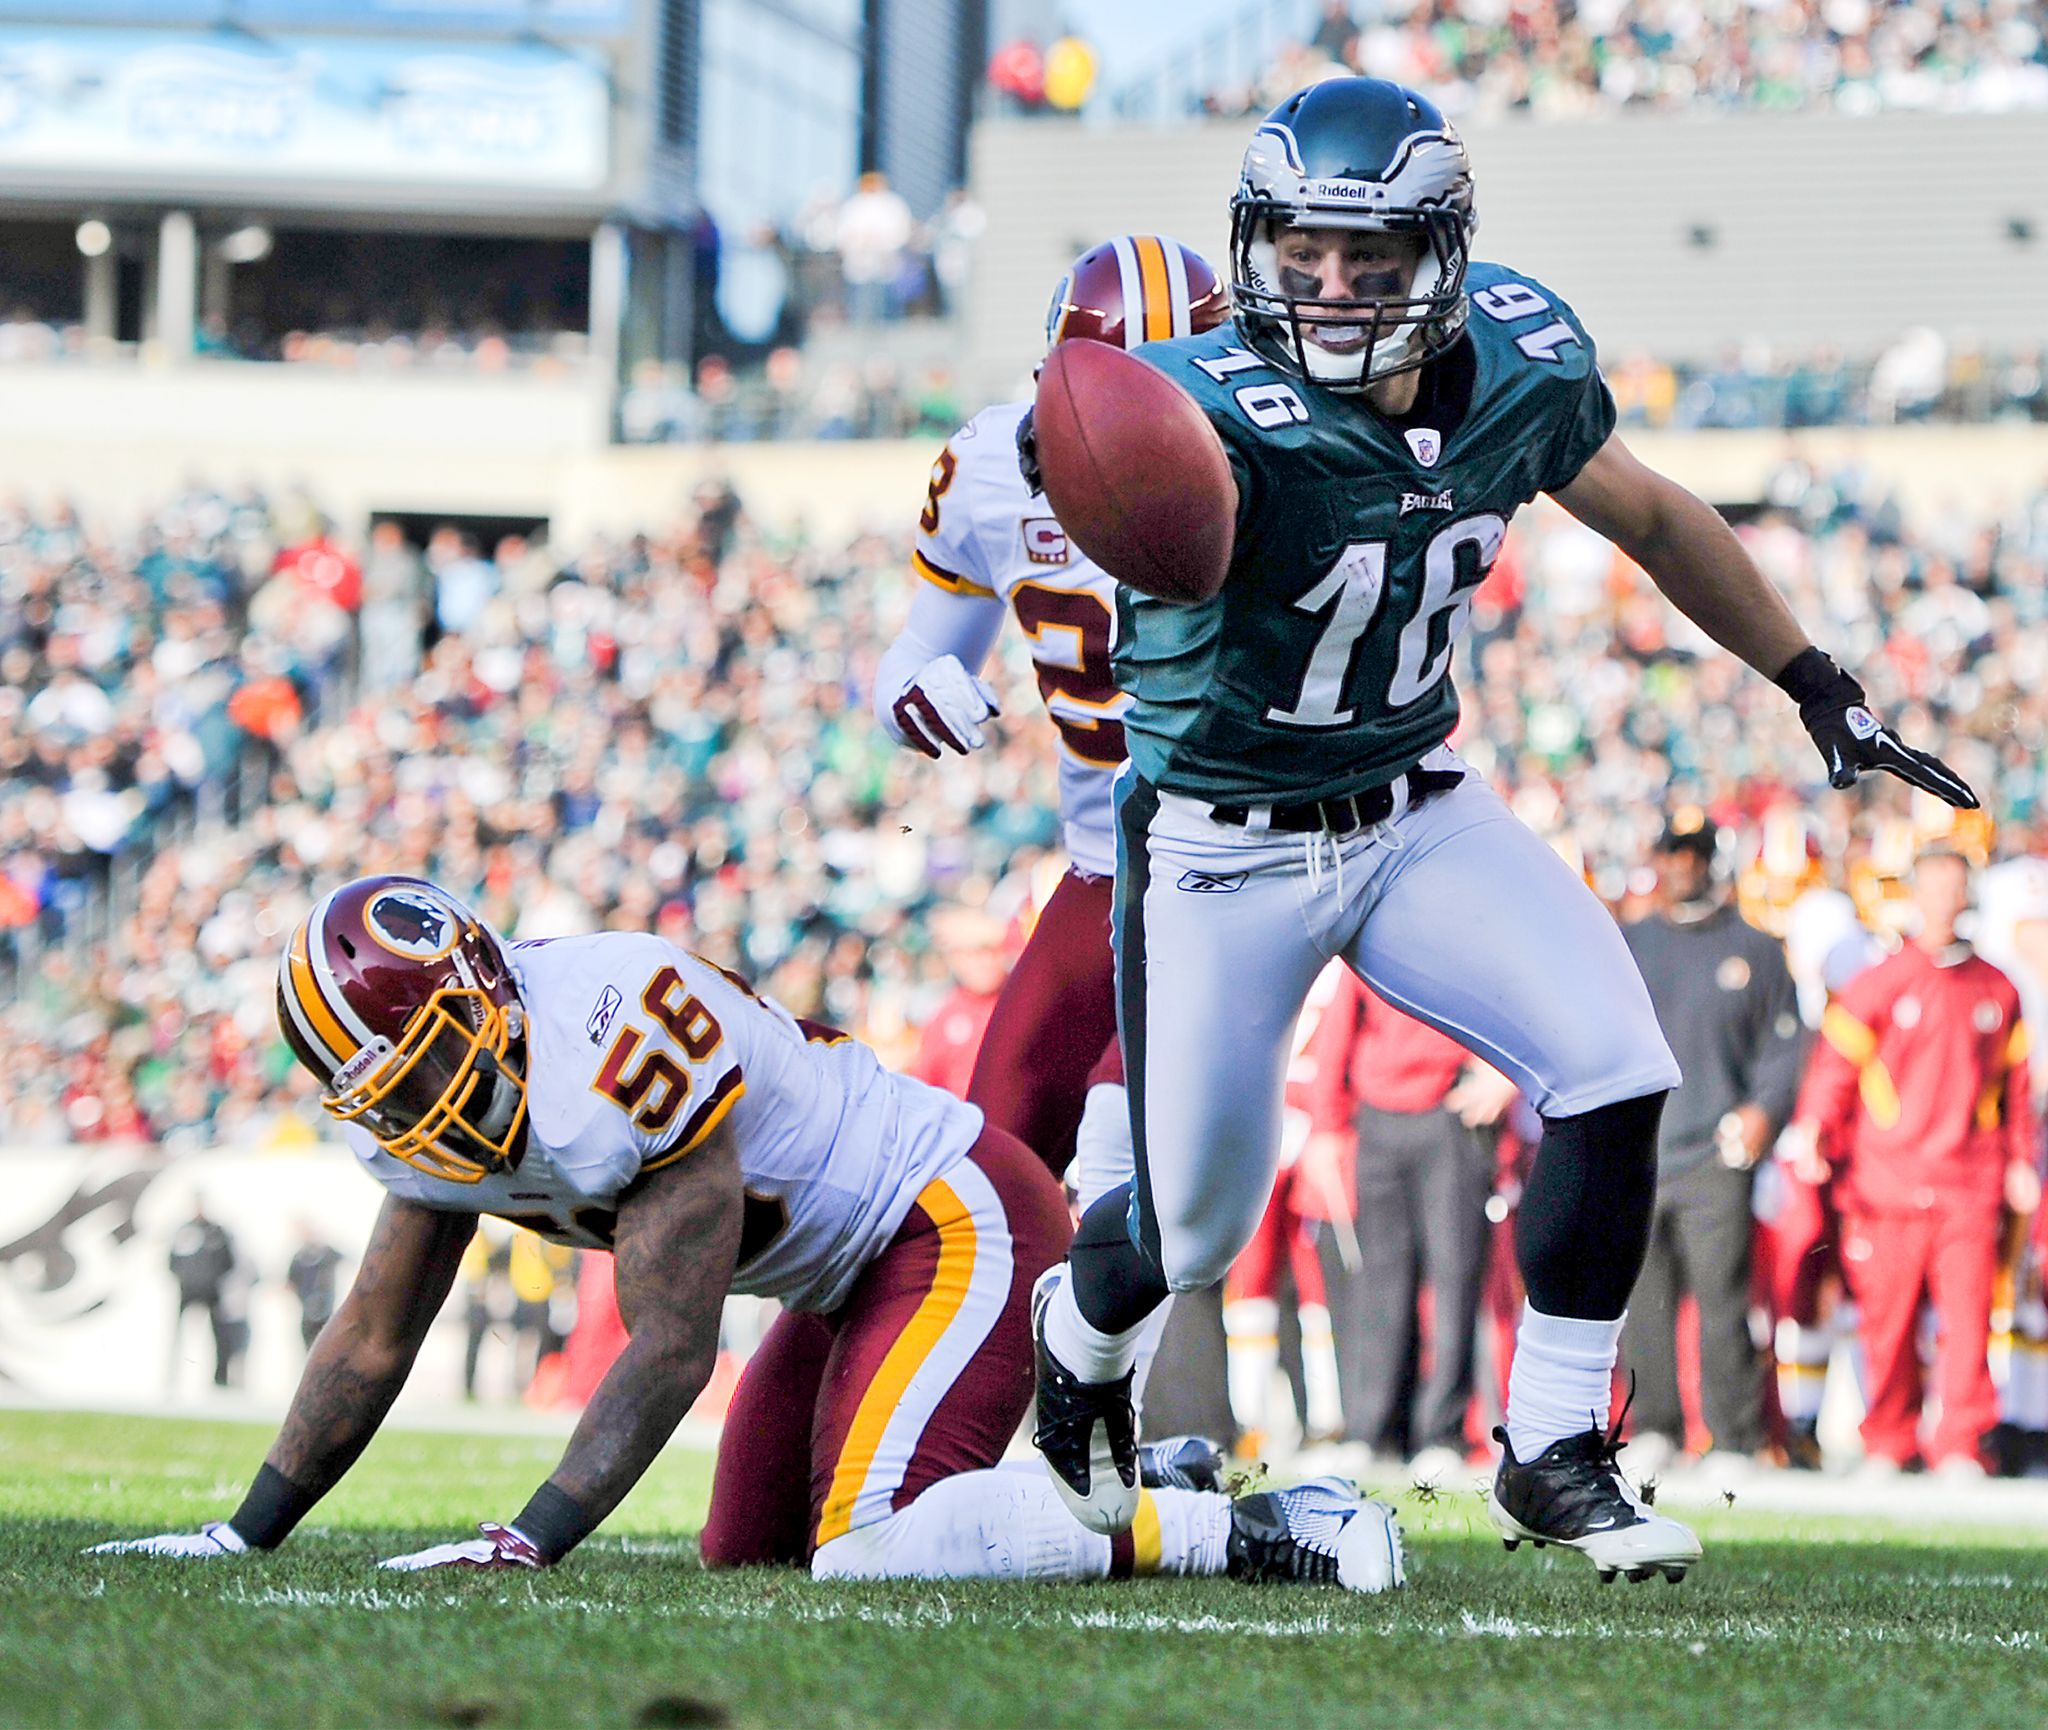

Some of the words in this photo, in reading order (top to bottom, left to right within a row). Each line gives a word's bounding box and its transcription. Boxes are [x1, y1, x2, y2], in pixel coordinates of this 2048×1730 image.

[1318, 184, 1367, 199] Riddell
[1470, 281, 1584, 364] 16
[1190, 346, 1311, 431] 16
[1399, 488, 1454, 518] EAGLES
[1024, 519, 1067, 555] C
[1264, 513, 1507, 726] 16
[343, 1048, 377, 1079] Riddell
[590, 965, 724, 1135] 56
